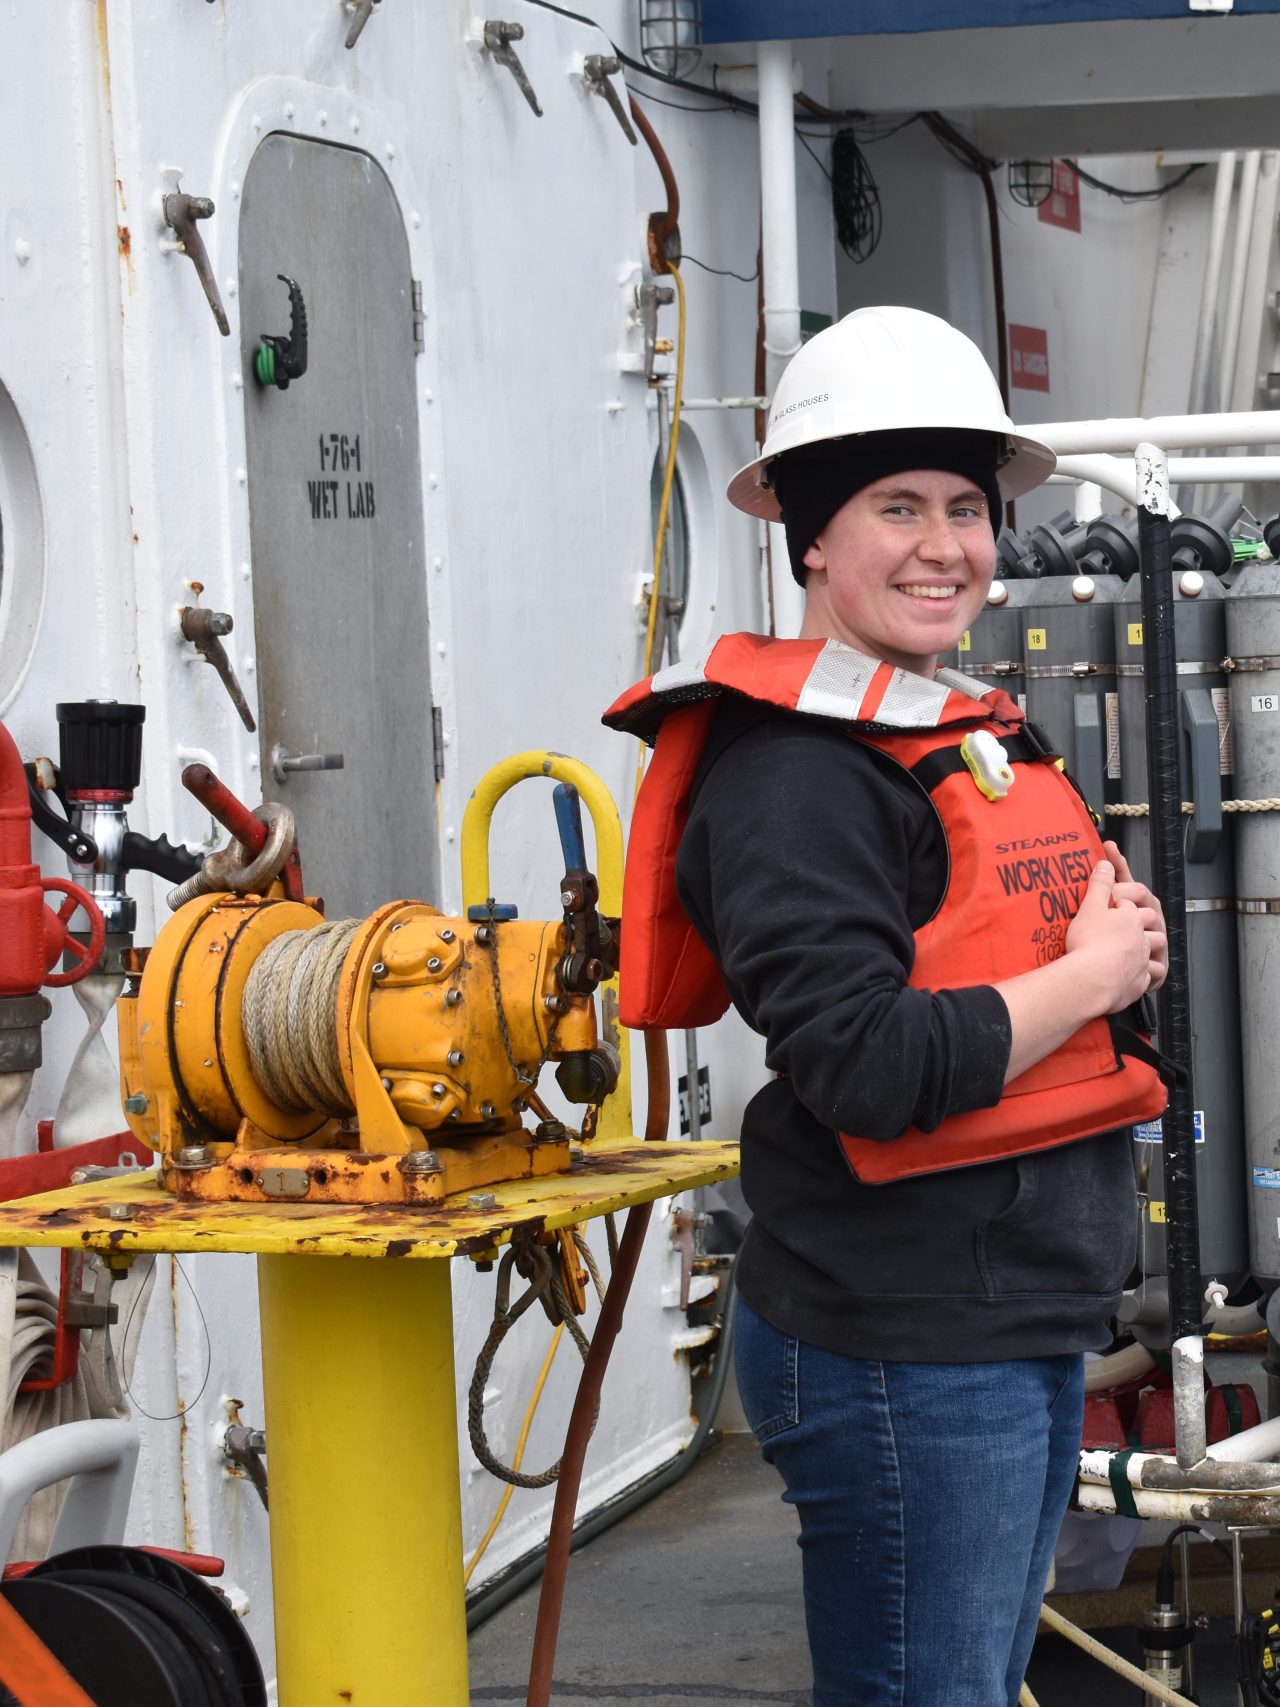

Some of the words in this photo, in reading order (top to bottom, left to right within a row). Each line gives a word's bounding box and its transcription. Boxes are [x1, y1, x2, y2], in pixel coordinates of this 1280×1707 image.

[797, 393, 829, 409] HOUSES
[319, 433, 361, 472] 1-76-1
[307, 480, 339, 519] WET
[347, 481, 376, 519] LAB
[1032, 634, 1041, 644] 18
[1258, 697, 1273, 710] 16
[995, 832, 1080, 854] STEARNS
[996, 856, 1058, 896] WORK
[1051, 849, 1093, 885] VEST
[1039, 885, 1080, 923] ONLY
[277, 1171, 286, 1192] 1
